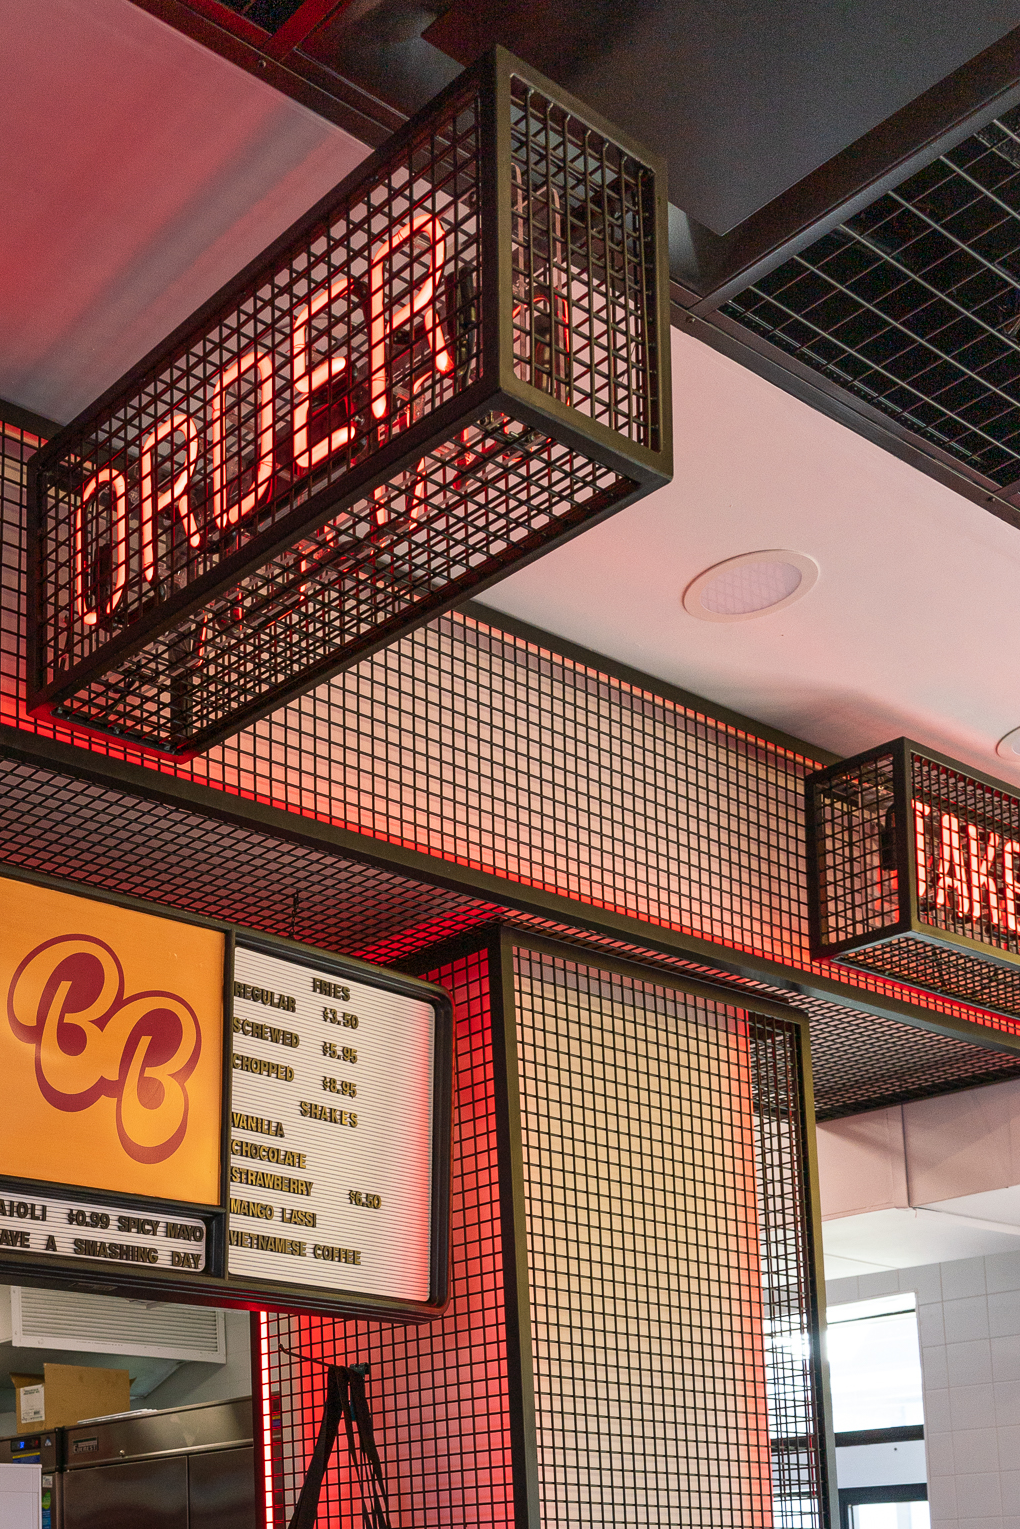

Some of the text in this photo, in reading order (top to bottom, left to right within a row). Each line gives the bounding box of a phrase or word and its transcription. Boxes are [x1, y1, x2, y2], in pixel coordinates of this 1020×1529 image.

[75, 213, 454, 626] ORDER
[233, 980, 359, 1030] REGULAR $3.50
[312, 977, 351, 1001] FRIES
[232, 1016, 358, 1064] SCREWED $5.95
[232, 1053, 358, 1099] CHOPPED $8.95
[231, 1112, 286, 1138] VANILLA
[299, 1100, 359, 1128] SHAKES
[230, 1138, 307, 1169] CHOCOLATE
[230, 1166, 382, 1210] STRAWBERRY $6.50
[68, 1208, 111, 1230] $0.99
[118, 1215, 161, 1237] SPICY
[166, 1221, 205, 1243] MAYO
[229, 1197, 317, 1228] MANGO LASSI
[45, 1234, 58, 1252] A
[73, 1237, 159, 1265] SMASHING
[171, 1251, 203, 1270] DAY
[228, 1229, 362, 1266] VIETNAMESE COFFEE
